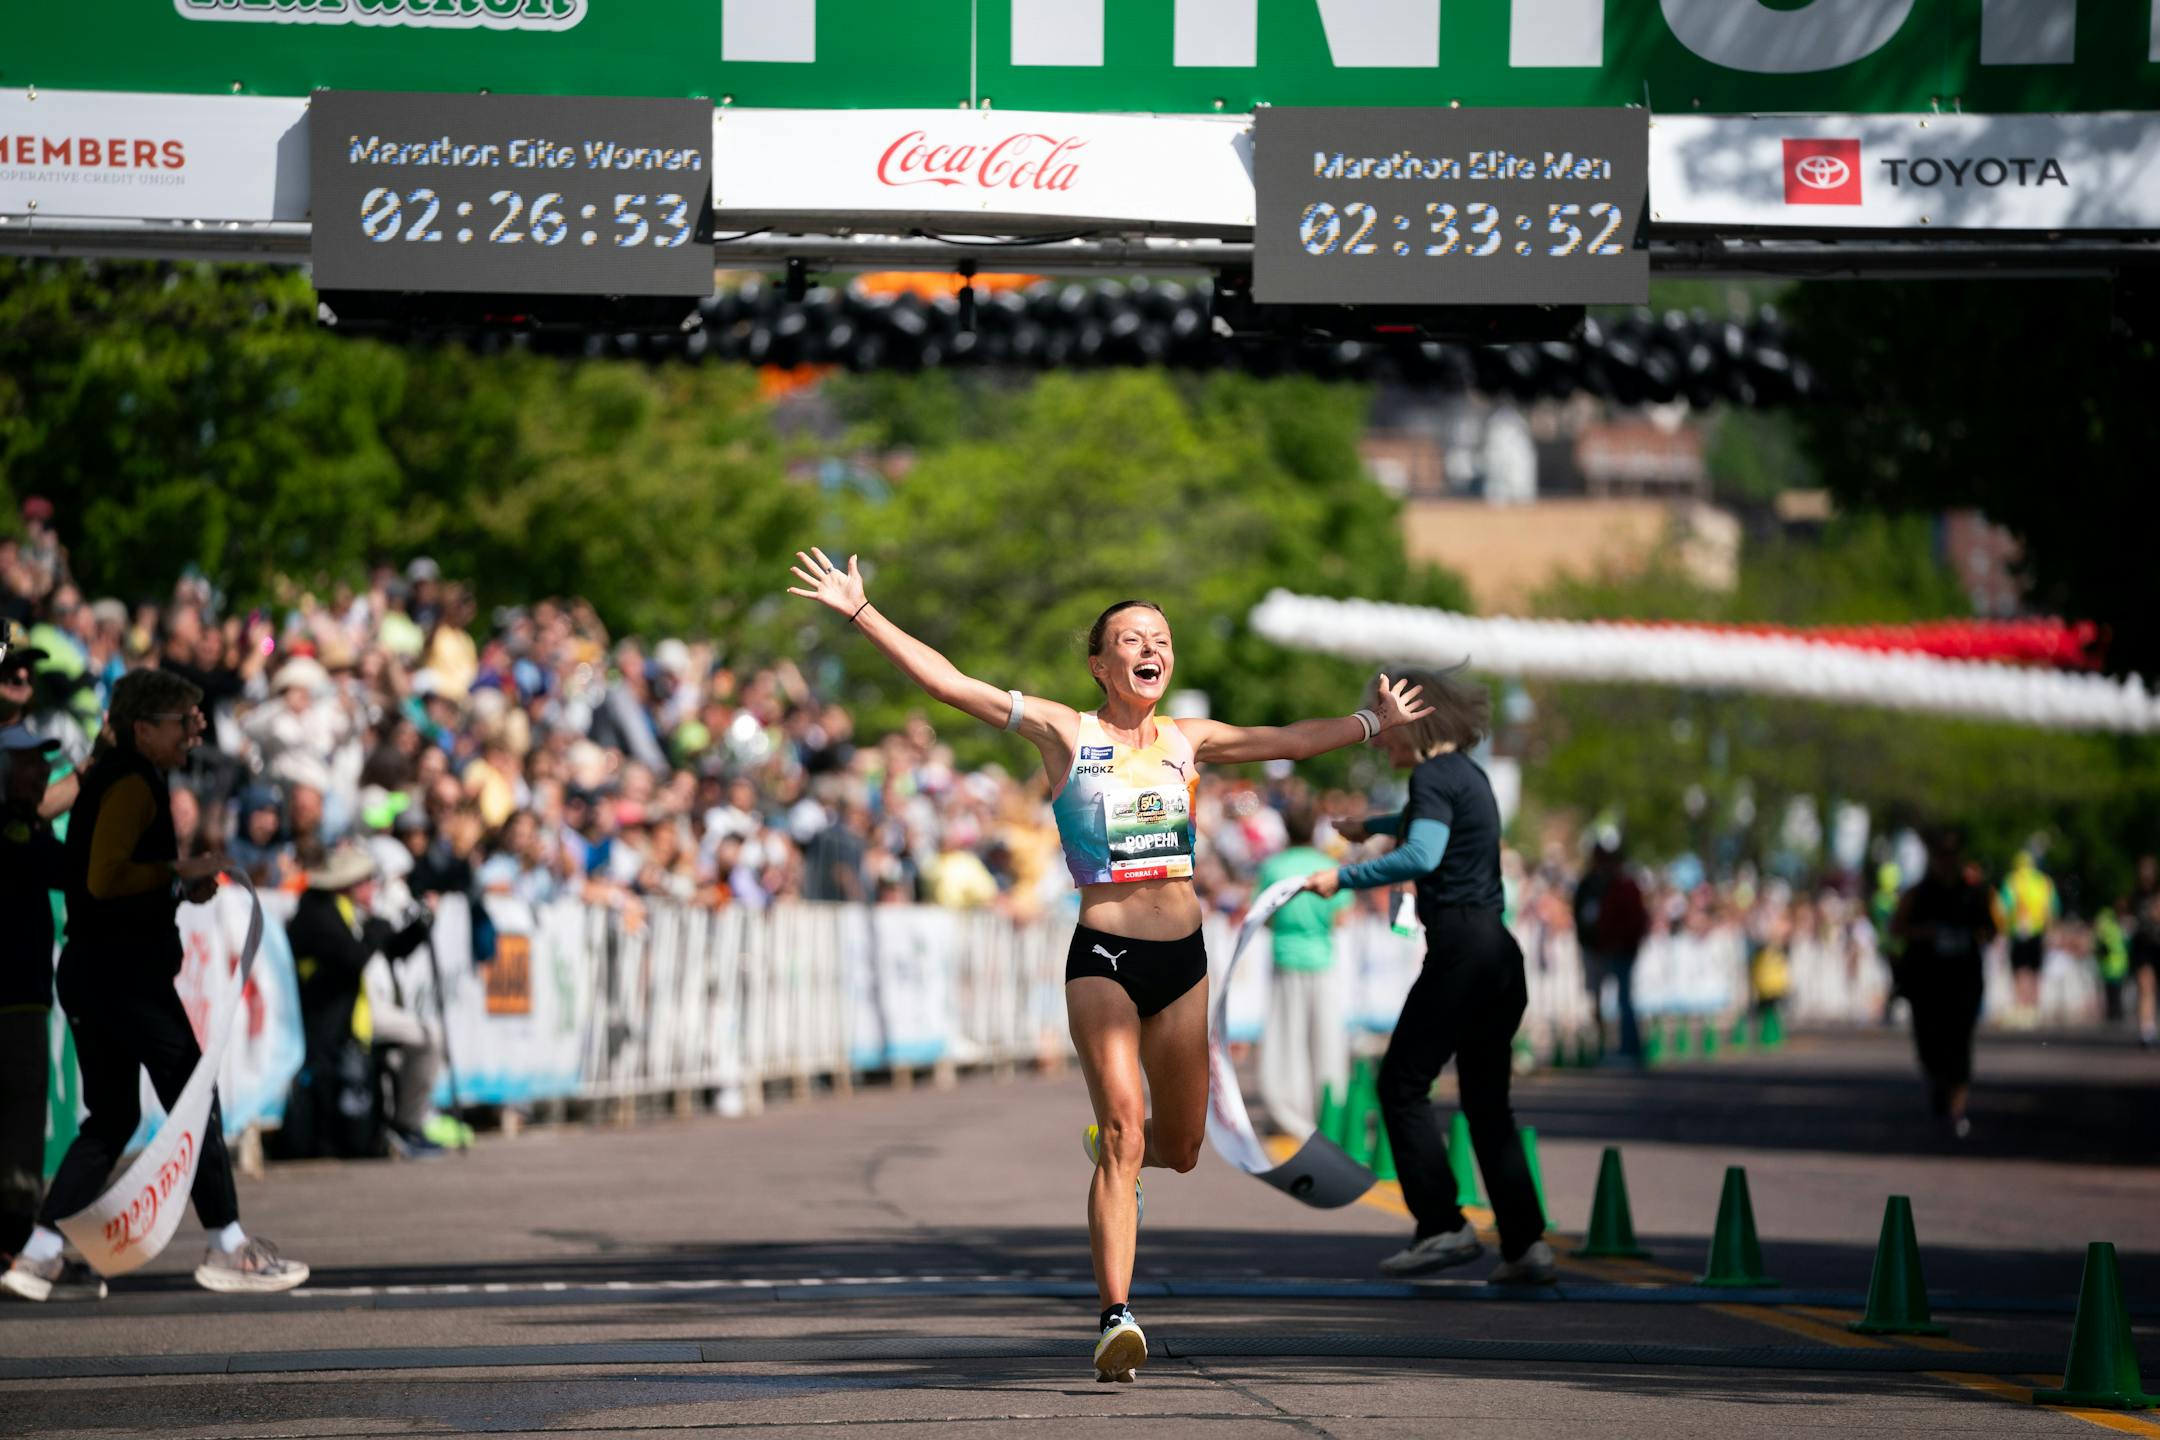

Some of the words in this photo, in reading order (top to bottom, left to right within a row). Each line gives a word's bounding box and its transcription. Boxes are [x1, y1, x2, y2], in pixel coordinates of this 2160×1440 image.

[350, 135, 500, 167] Marathon
[508, 138, 577, 169] Elite
[584, 140, 702, 171] Women
[1313, 150, 1461, 180] Marathon
[1468, 150, 1537, 180] Elite
[1544, 151, 1612, 180] Men
[83, 171, 135, 185] CREDIT
[138, 173, 186, 186] UNION
[1881, 157, 2070, 188] TOYOTA
[361, 187, 692, 248] 02:26:53
[1300, 202, 1625, 257] 02:33:52
[1076, 766, 1113, 774] SHOKZ
[1124, 870, 1152, 878] CORRAL
